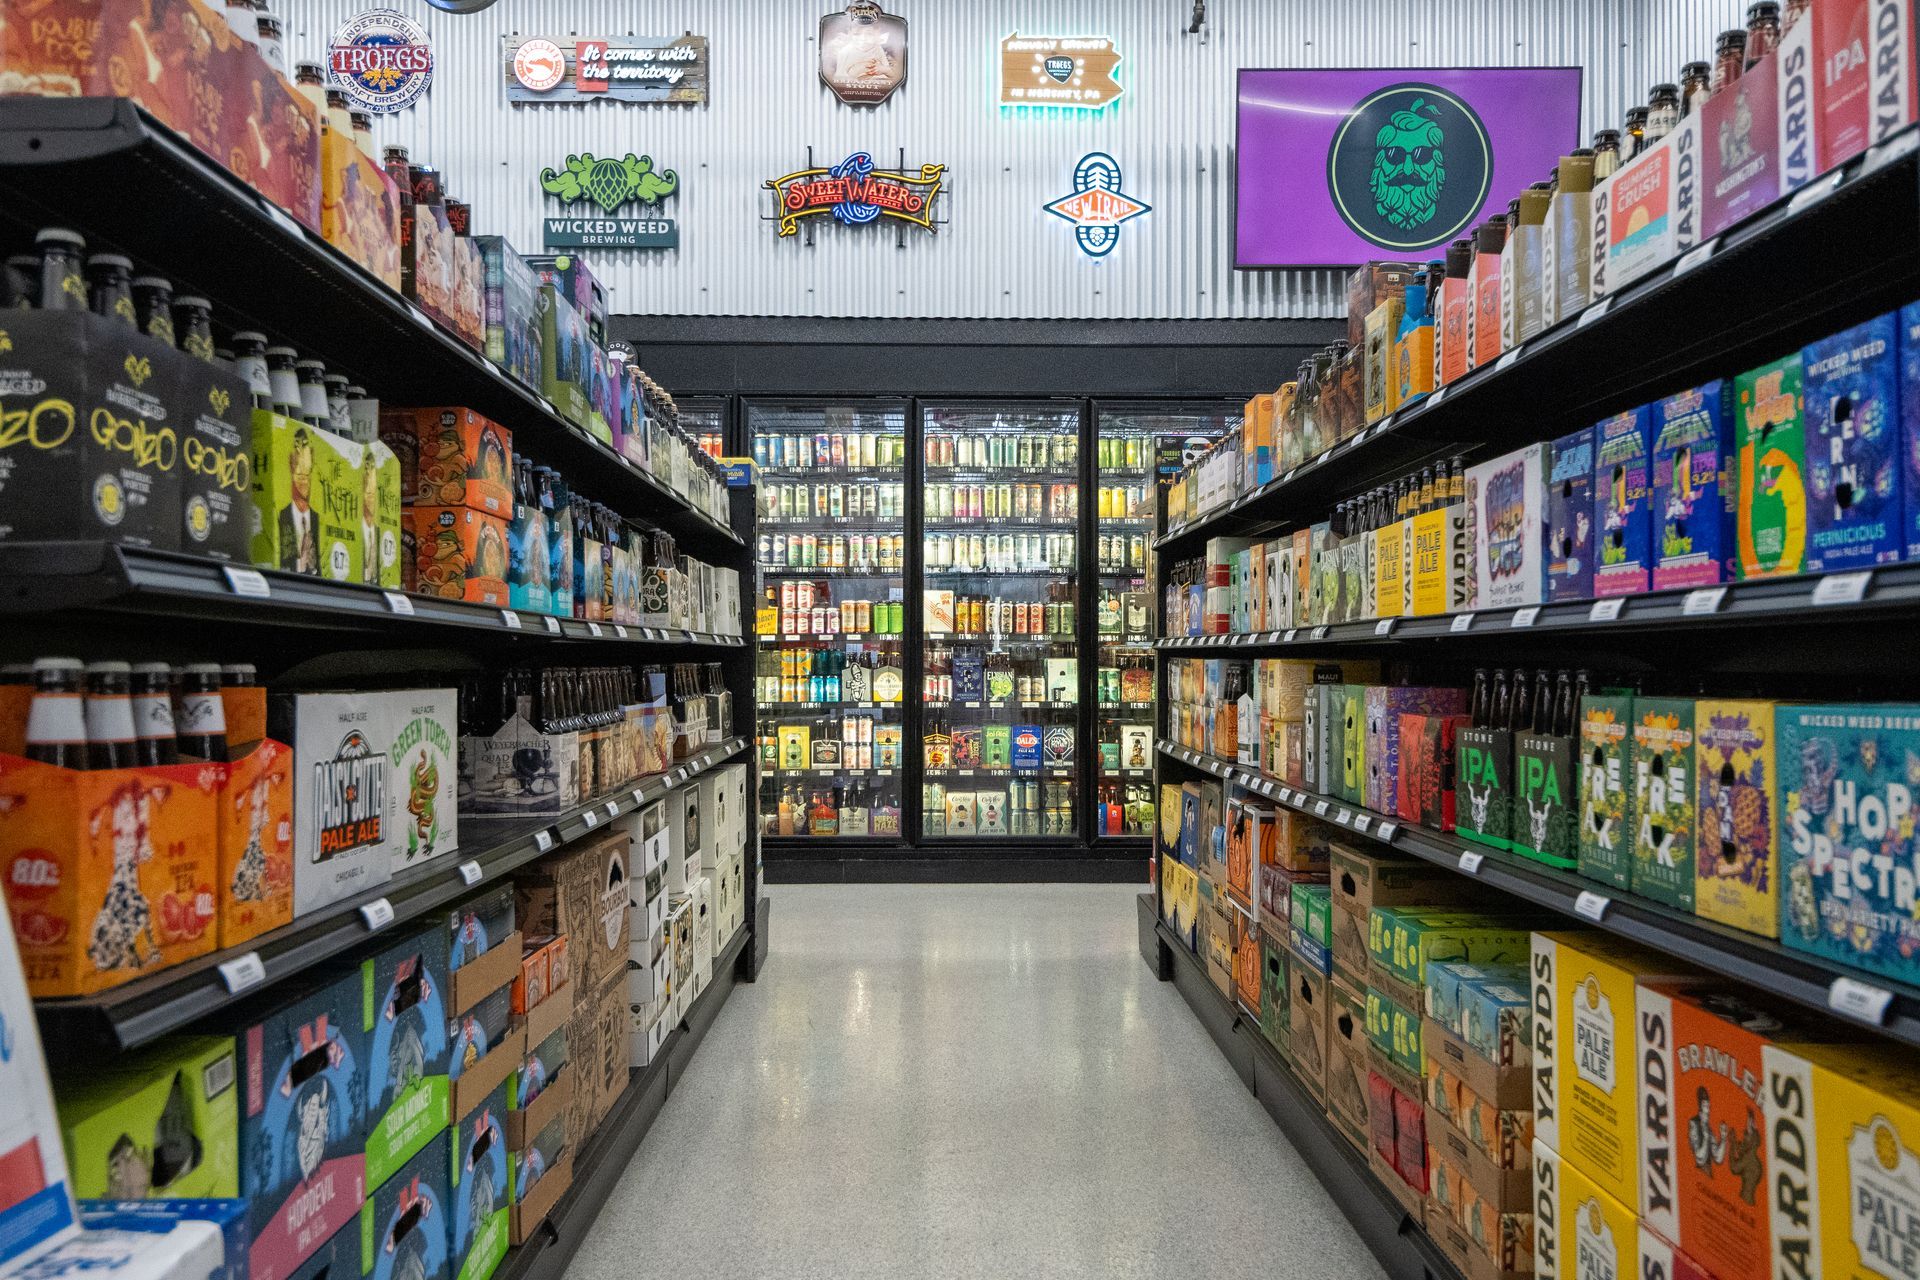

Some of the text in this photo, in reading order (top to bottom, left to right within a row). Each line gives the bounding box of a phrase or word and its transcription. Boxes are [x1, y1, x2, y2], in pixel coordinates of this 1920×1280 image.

[344, 17, 419, 42] INDEPENDENT
[335, 42, 428, 71] TRÖEGS
[581, 44, 697, 62] It comes with
[1826, 40, 1865, 86] IPA
[582, 63, 685, 84] the territory
[1878, 0, 1899, 142] YARD
[343, 75, 421, 103] CRAFT BREWERY
[1619, 159, 1662, 192] SUMMER
[1064, 193, 1131, 219] NEW TRAIL
[1617, 175, 1661, 213] CRUSH
[549, 221, 669, 234] WICKED WEED
[583, 235, 636, 244] BREWING
[608, 343, 630, 351] OOSE
[1808, 340, 1886, 377] WICKED WEED
[383, 431, 418, 446] CTORY
[1380, 542, 1399, 563] PALE
[1416, 530, 1441, 554] PALE
[1813, 524, 1886, 548] PERNICIOUS
[1369, 538, 1377, 612] YARDS
[1381, 560, 1398, 583] ALE
[1403, 526, 1412, 609] YARDS
[1419, 551, 1438, 574] ALE
[1464, 732, 1493, 744] STONE
[1800, 715, 1882, 730] WICKED WEED
[391, 717, 451, 768] GREEN TORCH
[482, 754, 510, 763] QUAD
[1391, 720, 1399, 783] STONE
[1524, 739, 1555, 752] STONE
[1461, 747, 1499, 789] IPA
[1519, 756, 1562, 805] IPA
[874, 821, 898, 831] HAZE
[1834, 780, 1911, 841] HOP
[320, 825, 355, 854] PALE
[357, 817, 381, 843] ALE
[1793, 808, 1920, 911] SPECTR
[601, 884, 629, 916] BOURBON
[1469, 936, 1531, 945] STONE
[1535, 952, 1553, 1126] YARDS
[1577, 1023, 1611, 1062] PALE
[1581, 1046, 1608, 1082] ALE
[1643, 1011, 1672, 1217] YARDS
[1772, 1073, 1809, 1280] ARDS
[288, 1173, 335, 1235] HOPDEVIL
[1537, 1158, 1555, 1280] RDS
[1859, 1186, 1920, 1242] PALE
[1867, 1225, 1919, 1280] ALE
